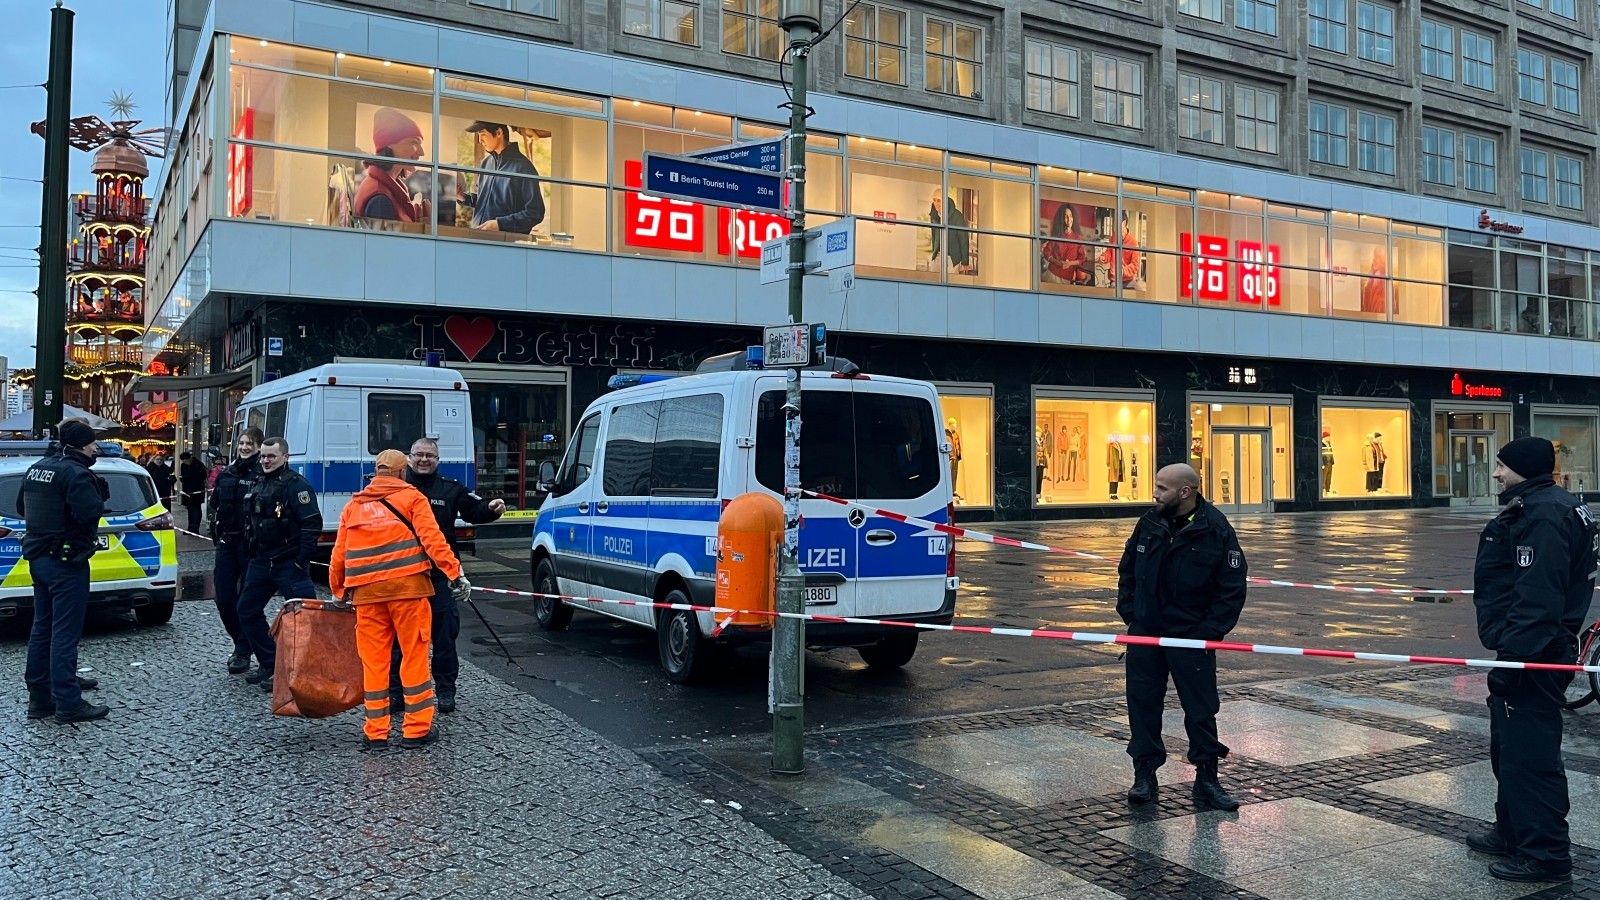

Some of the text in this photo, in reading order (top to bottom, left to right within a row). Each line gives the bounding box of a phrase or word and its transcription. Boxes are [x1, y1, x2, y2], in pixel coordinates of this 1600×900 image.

[730, 150, 750, 159] Center
[760, 146, 770, 154] 300
[760, 155, 770, 163] 500
[681, 174, 700, 185] Berlin
[703, 178, 725, 189] Tourist
[726, 182, 739, 191] Info
[757, 187, 767, 195] 250
[1243, 248, 1273, 273] UNI
[1243, 273, 1276, 299] QLO
[497, 320, 665, 369] Berlin
[1244, 368, 1255, 376] UNI
[1465, 384, 1502, 397] Sparkasse
[444, 408, 457, 417] 15
[27, 468, 55, 483] POLIZEI
[363, 501, 385, 518] BSR
[604, 535, 632, 555] POLIZEI
[707, 538, 717, 554] 14
[930, 539, 945, 554] 14
[805, 588, 831, 601] 1880
